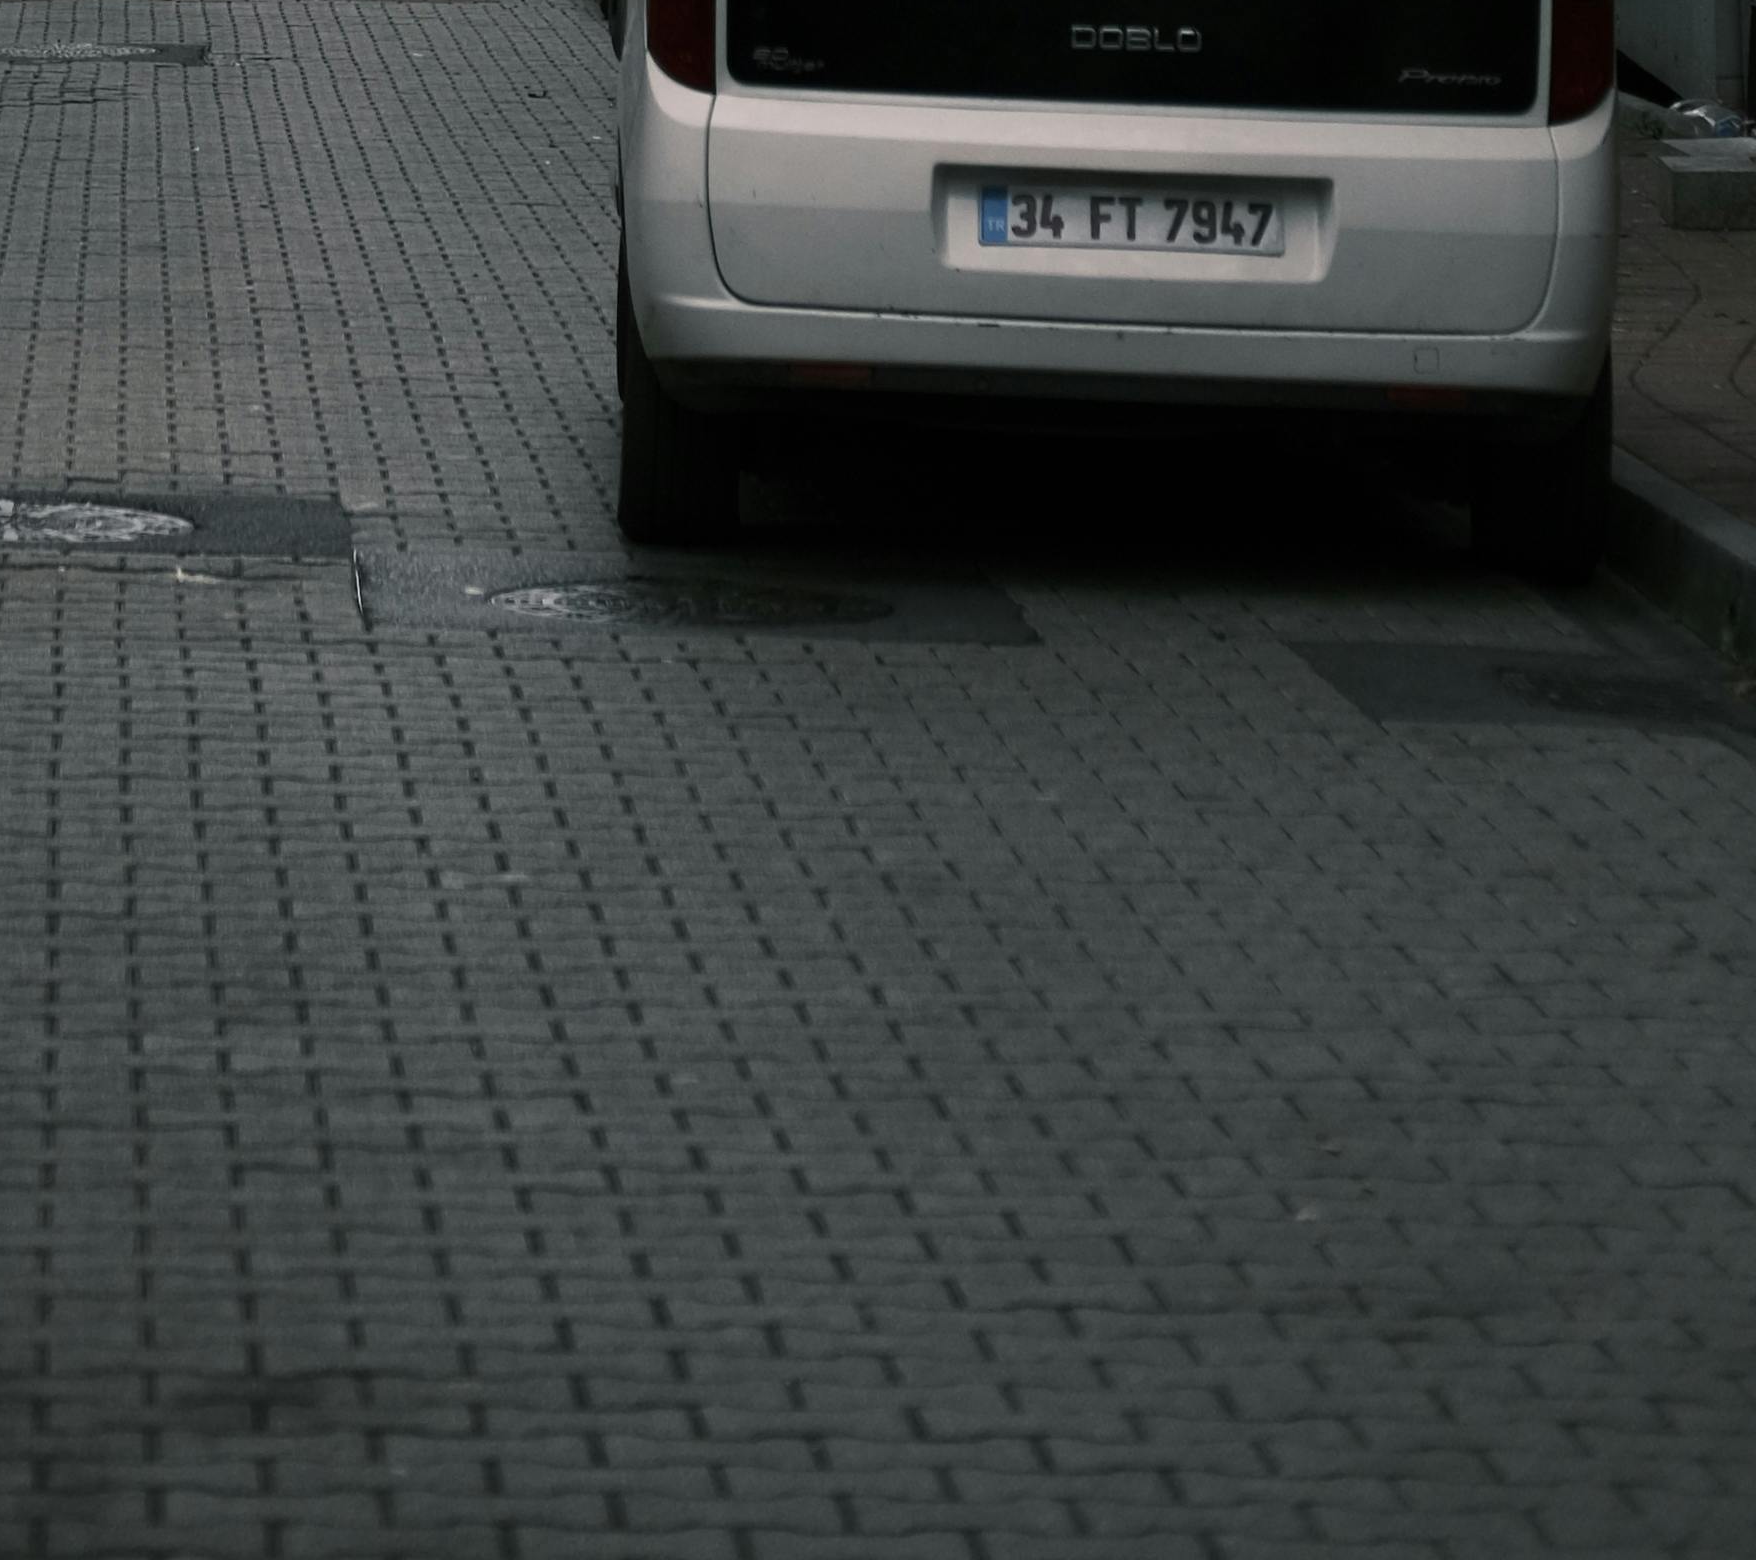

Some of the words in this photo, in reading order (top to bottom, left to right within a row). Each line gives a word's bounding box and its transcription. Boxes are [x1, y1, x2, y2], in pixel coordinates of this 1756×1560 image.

[987, 219, 1006, 233] TR
[1011, 193, 1065, 240] 34
[1089, 195, 1143, 242] FT
[1163, 197, 1274, 248] 7947
